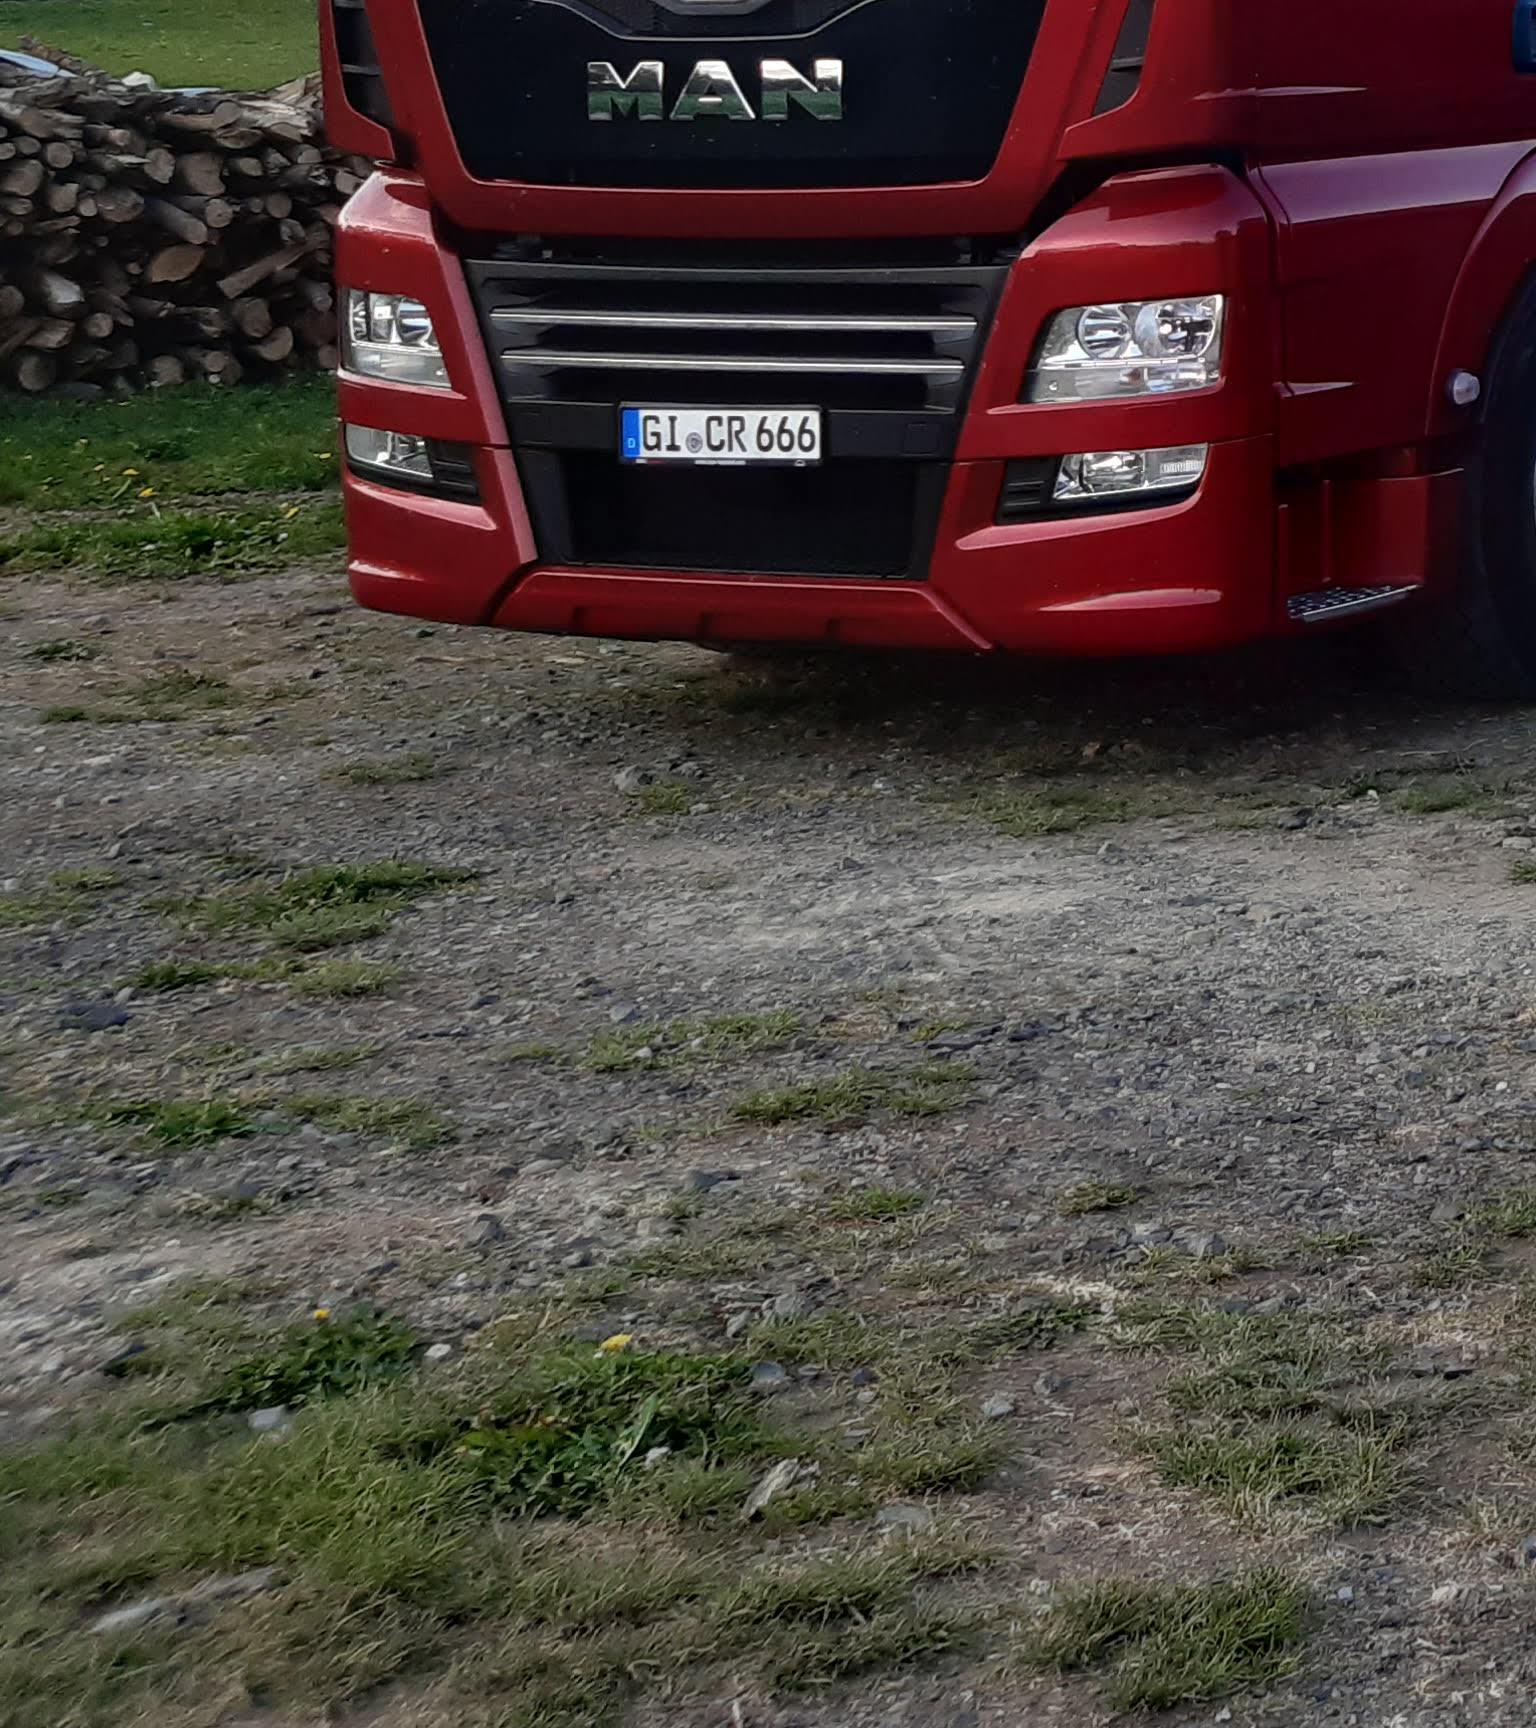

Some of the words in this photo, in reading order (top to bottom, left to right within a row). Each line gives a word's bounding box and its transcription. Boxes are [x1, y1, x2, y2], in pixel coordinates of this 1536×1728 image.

[588, 59, 843, 121] MAN
[627, 438, 636, 449] D
[642, 415, 681, 451] GI
[706, 415, 747, 452] CR
[756, 416, 816, 452] 666
